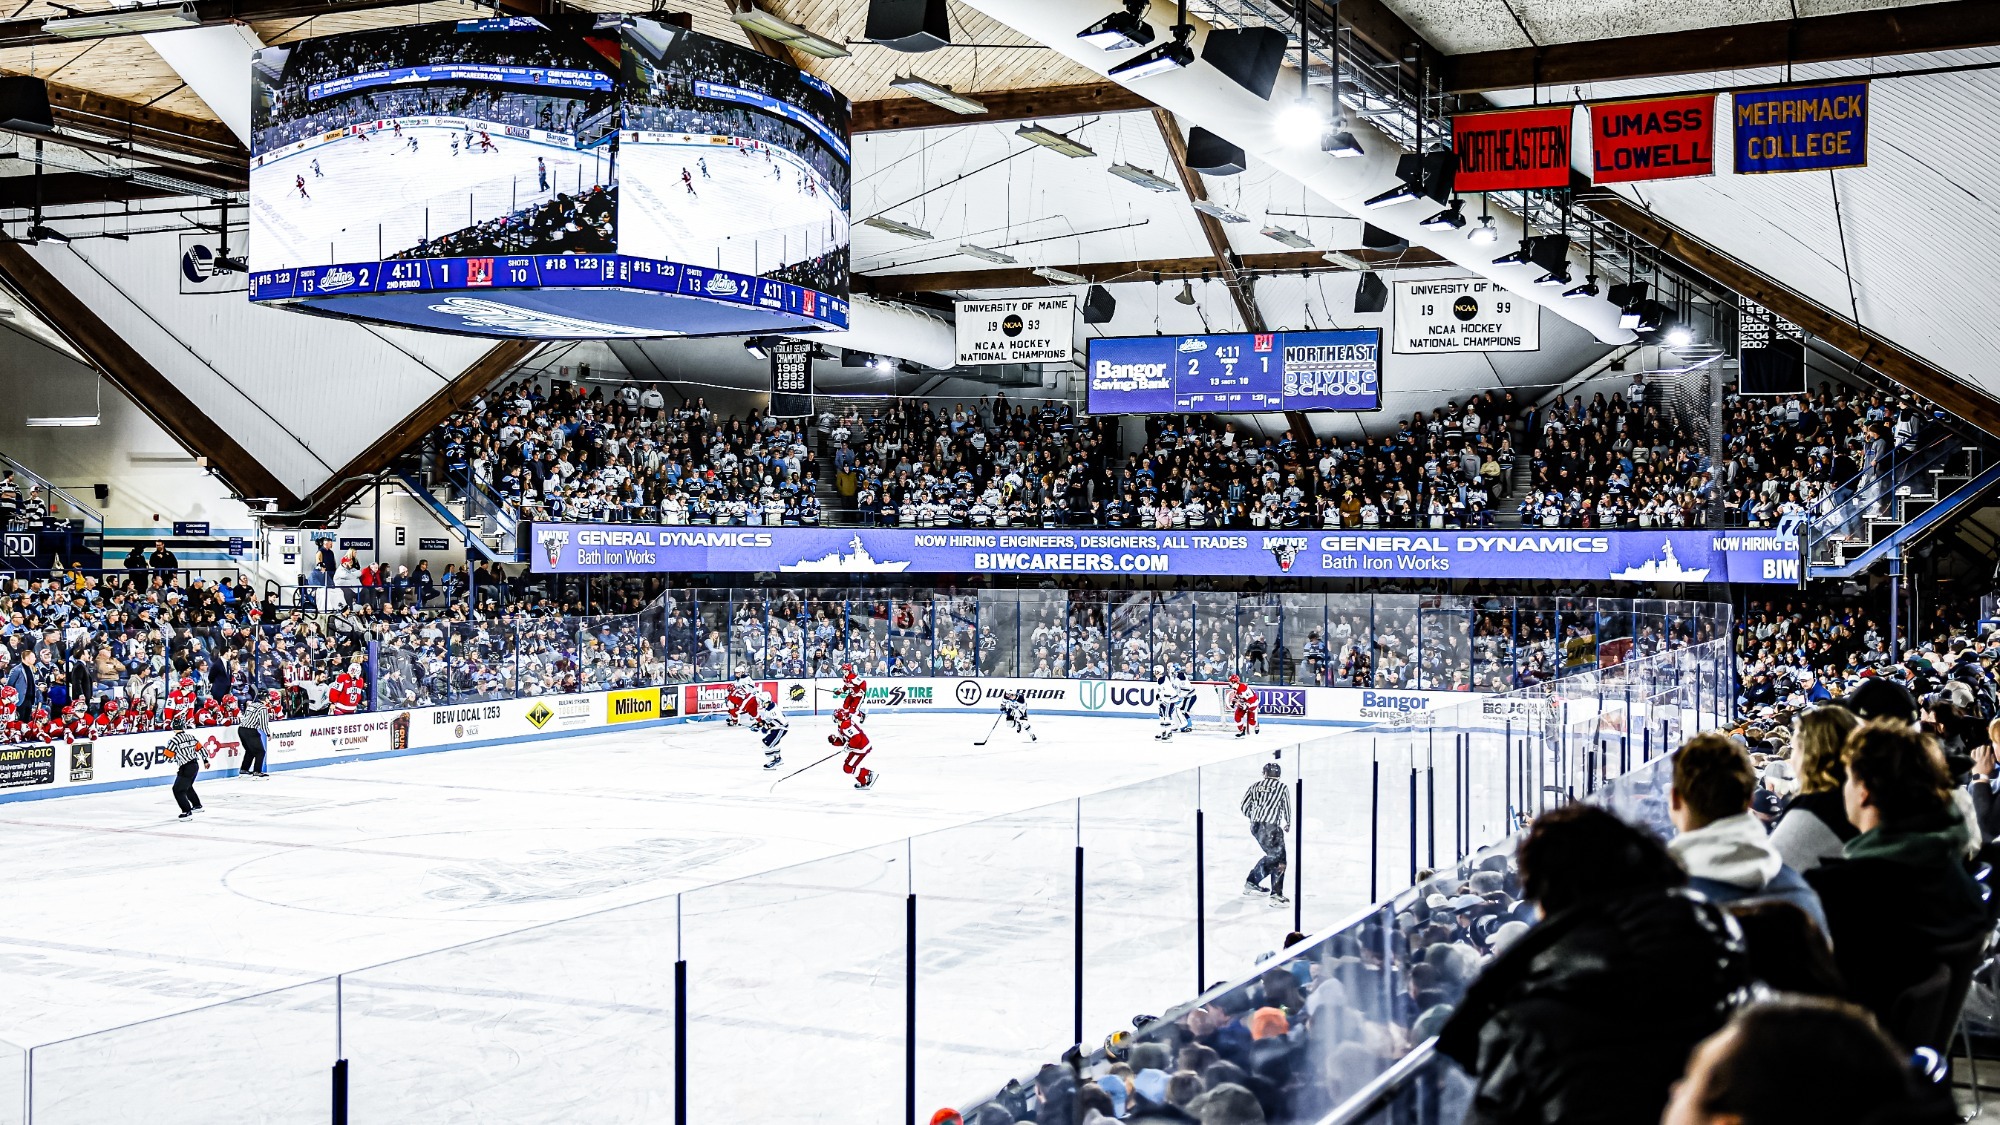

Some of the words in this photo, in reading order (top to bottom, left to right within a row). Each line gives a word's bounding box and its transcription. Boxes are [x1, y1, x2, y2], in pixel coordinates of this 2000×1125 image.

[547, 71, 592, 80] GENERAL
[1737, 94, 1862, 128] MERRIMACK
[1602, 108, 1703, 138] UMASS
[546, 132, 569, 143] Bangor
[1456, 125, 1568, 174] NORTHEASTERN
[1747, 131, 1852, 160] COLLEGE
[1595, 141, 1711, 172] LOWELL
[466, 258, 494, 282] BU
[508, 259, 529, 267] SHOTS
[545, 258, 567, 270] #18
[574, 258, 598, 270] 1:23
[605, 260, 615, 280] PEN
[634, 261, 651, 273] #15
[656, 263, 675, 277] 1:23
[300, 269, 316, 277] SHOTS
[359, 268, 369, 287] 2
[392, 262, 421, 279] 4:11
[441, 264, 449, 282] 1
[510, 269, 527, 282] 10
[620, 262, 628, 280] PEN
[686, 268, 702, 277] SHOTS
[259, 274, 272, 286] #15
[275, 272, 291, 283] 1:23
[302, 280, 314, 292] 13
[317, 267, 356, 291] Maine
[386, 280, 399, 289] 2ND
[399, 279, 421, 288] PERIOD
[688, 278, 701, 292] 13
[704, 272, 738, 296] Maine
[740, 280, 749, 298] 2
[763, 282, 782, 299] 4:11
[1411, 283, 1469, 295] UNIVERSITY
[1474, 282, 1488, 293] OF
[791, 290, 796, 308] 1
[963, 303, 1018, 313] UNIVERSITY
[1021, 302, 1034, 311] OF
[1038, 300, 1068, 310] MAINE
[1421, 305, 1434, 316] 19
[1455, 304, 1477, 312] NCAA
[1496, 302, 1511, 314] 99
[988, 321, 998, 332] 19
[1003, 321, 1023, 329] NCAA
[1028, 320, 1040, 330] 93
[1428, 325, 1456, 335] NCAA
[1460, 323, 1503, 333] HOCKEY
[794, 344, 811, 353] SEASON
[975, 341, 1005, 350] NCAA
[1010, 339, 1051, 349] HOCKEY
[1254, 334, 1274, 352] BU
[1410, 337, 1459, 348] NATIONAL
[1463, 336, 1521, 347] CHAMPIONS
[776, 353, 807, 364] CHAMPIONS
[961, 352, 1007, 362] NATIONAL
[1012, 350, 1066, 360] CHAMPIONS
[1215, 346, 1240, 358] 4:11
[1284, 344, 1375, 363] NORTHEAST
[1096, 360, 1167, 382] Bangor
[1188, 358, 1199, 375] 2
[1225, 364, 1233, 376] 2
[1260, 356, 1269, 373] 1
[777, 372, 805, 381] 1993
[1210, 378, 1220, 386] 13
[1239, 377, 1249, 385] 10
[1284, 370, 1376, 384] DRIVING
[777, 381, 805, 389] 1995
[1092, 378, 1137, 392] Savings
[1139, 377, 1171, 390] Bank
[1284, 382, 1376, 396] SCHOOL
[396, 529, 404, 544] E
[537, 530, 569, 544] MAINE
[577, 531, 655, 546] GENERAL
[659, 532, 772, 547] DYNAMICS
[914, 535, 947, 547] NOW
[950, 535, 996, 548] HIRING
[1000, 535, 1078, 550] ENGINEERS,
[1081, 535, 1160, 551] DESIGNERS,
[1164, 536, 1188, 549] ALL
[1190, 536, 1248, 549] TRADES
[1262, 536, 1308, 550] MAINE
[7, 536, 33, 554] DD
[1321, 536, 1449, 552] GENERAL
[1457, 537, 1609, 553] DYNAMICS
[1713, 537, 1739, 551] NOW
[1742, 537, 1782, 551] HIRING
[578, 549, 602, 564] Bath
[603, 549, 623, 564] Iron
[625, 549, 656, 565] Works
[974, 553, 1169, 571] BIWCAREERS.COM
[1322, 554, 1359, 570] Bath
[1363, 554, 1394, 570] Iron
[1397, 554, 1449, 571] Works
[907, 687, 933, 698] TIRE
[1111, 687, 1154, 706] UCU
[615, 697, 652, 715] Milton
[661, 694, 676, 711] CAT
[1363, 691, 1429, 711] Bangor
[433, 711, 456, 725] IBEW
[457, 708, 480, 722] LOCAL
[483, 706, 500, 720] 1253
[1359, 708, 1402, 720] Savings
[272, 730, 302, 739] hannaford
[310, 726, 342, 737] MAINE'S
[343, 724, 361, 734] BEST
[364, 723, 375, 731] ON
[376, 722, 389, 730] ICE
[1, 750, 26, 760] ARMY
[28, 748, 53, 759] ROTC
[0, 763, 27, 771] University
